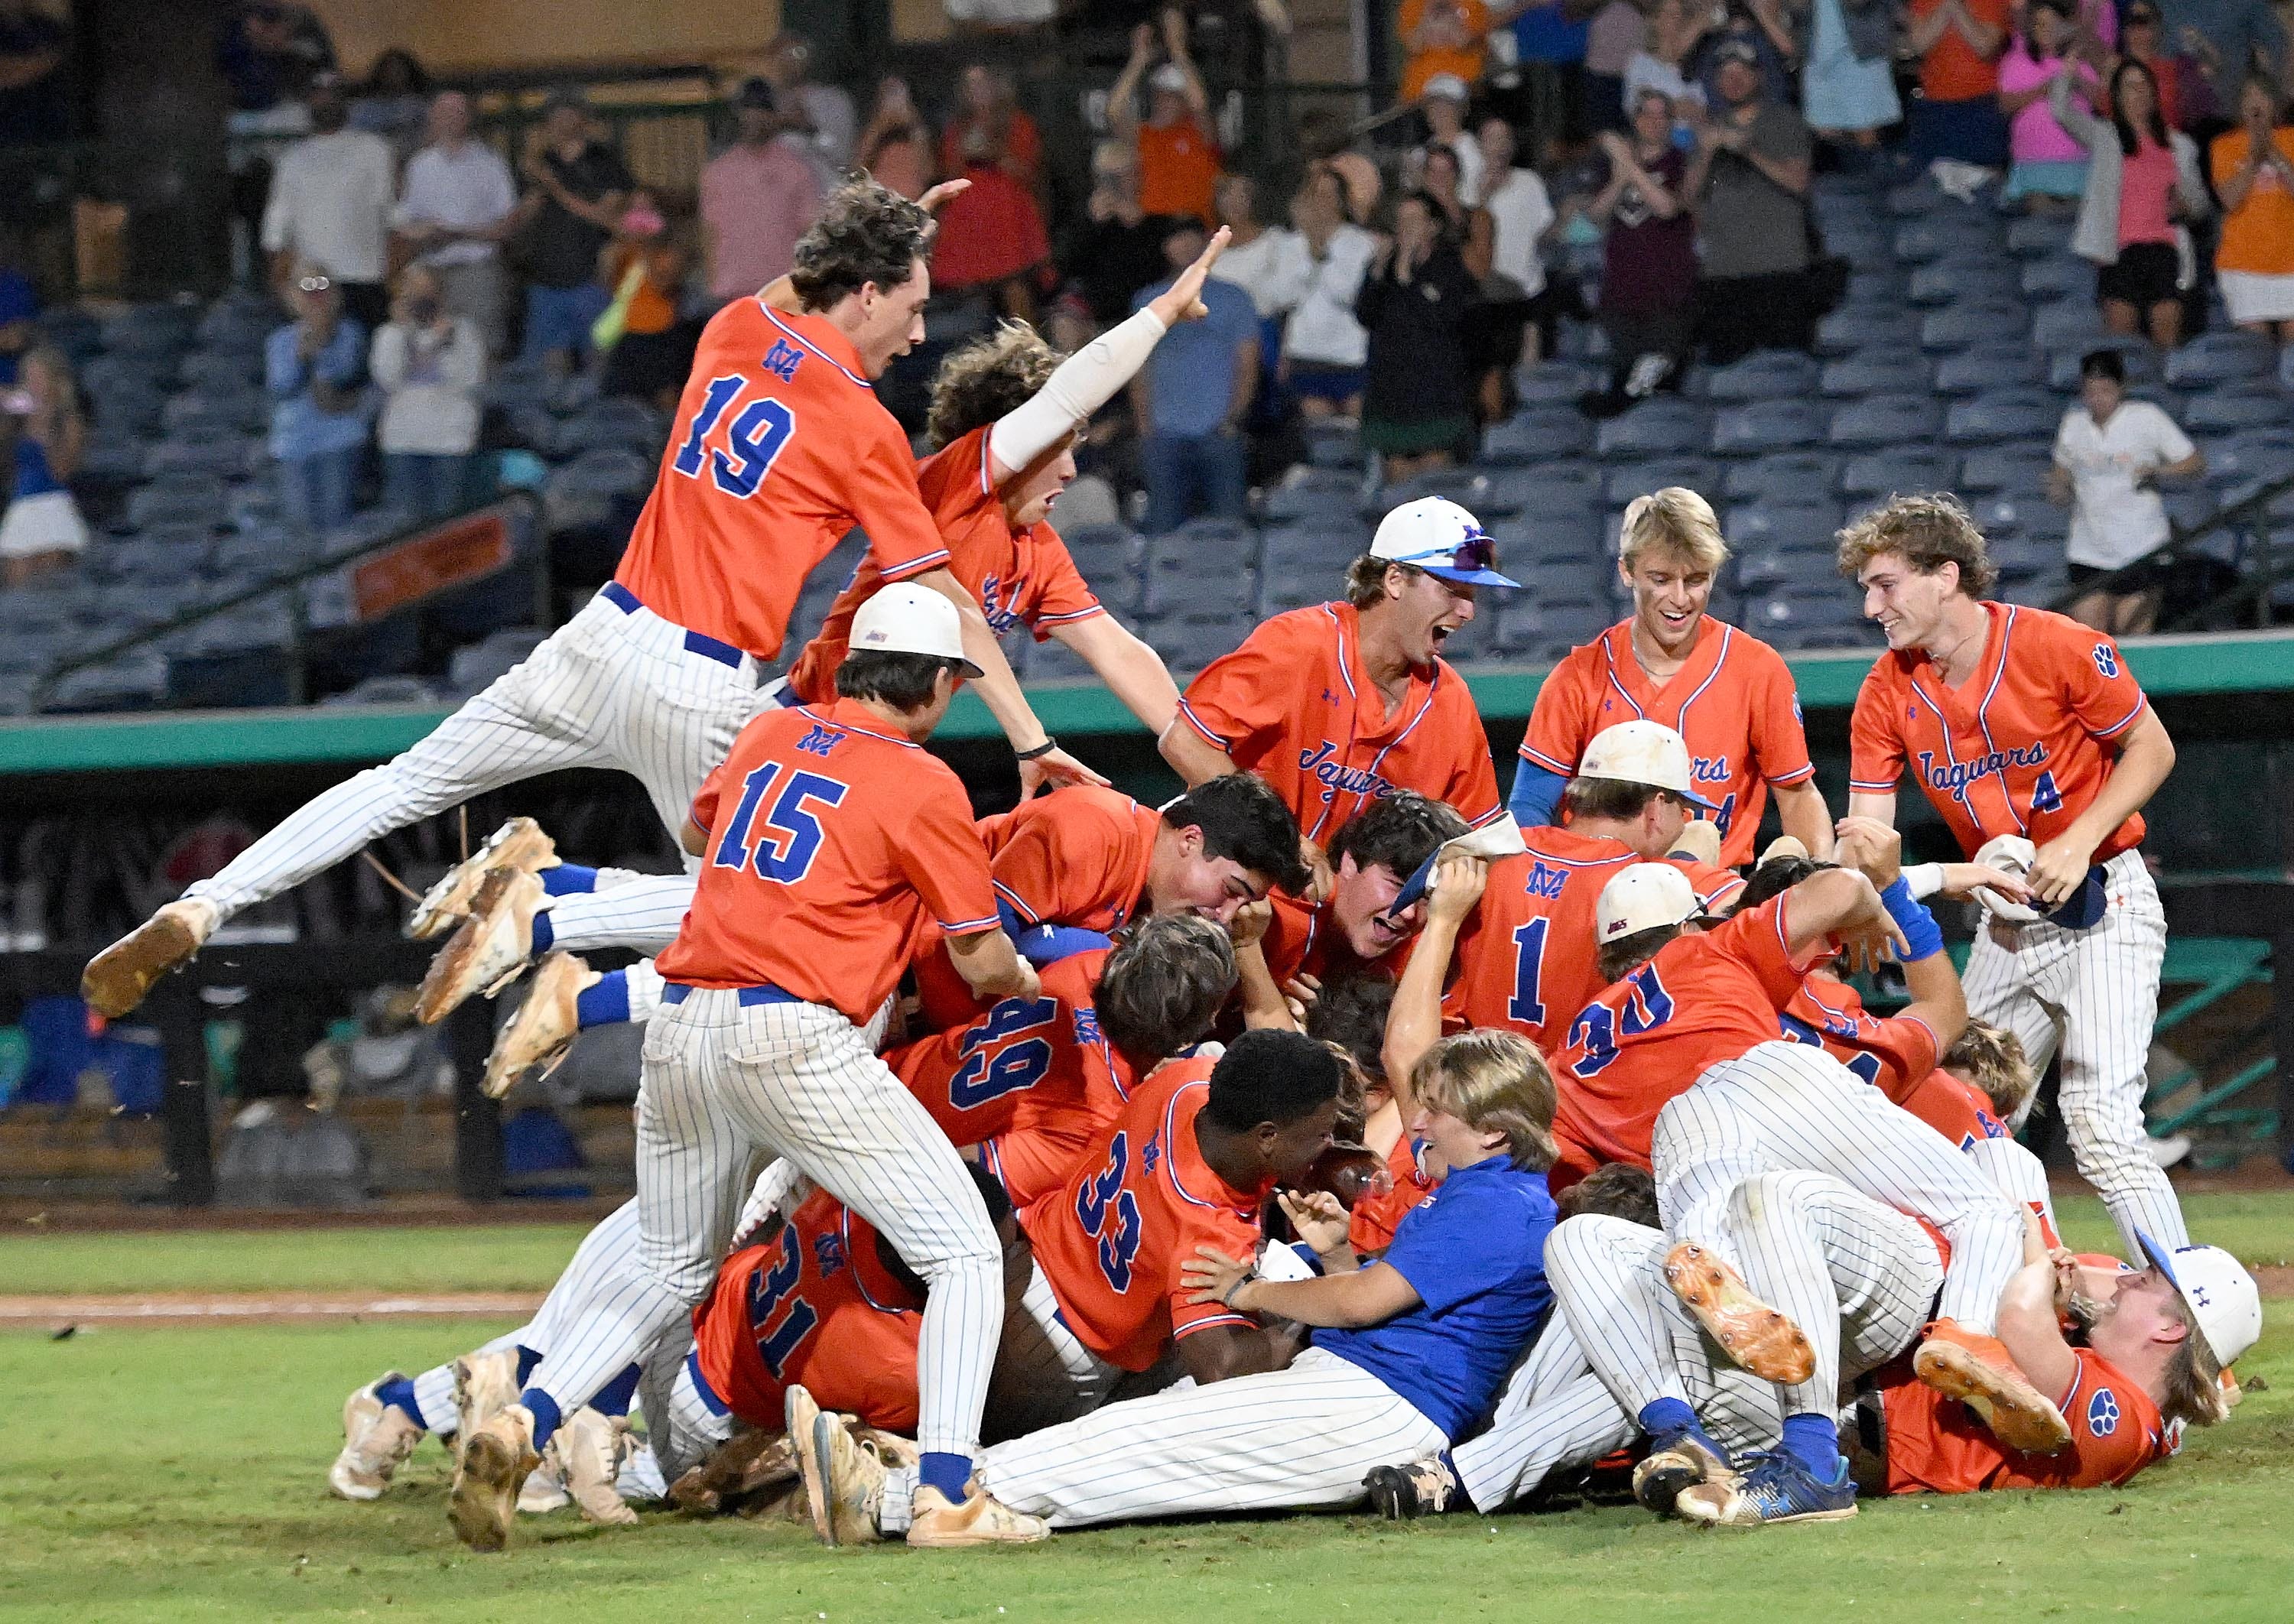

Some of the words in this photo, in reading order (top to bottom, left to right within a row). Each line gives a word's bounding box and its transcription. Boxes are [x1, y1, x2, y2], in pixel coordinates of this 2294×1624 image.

[672, 372, 795, 500] 19
[712, 759, 850, 886] 15
[1298, 739, 1396, 804] Jaguar
[1919, 741, 2050, 803] Jaguars
[2030, 770, 2063, 814] 4
[1507, 915, 1551, 1028] 1
[948, 996, 1058, 1112] 49
[1075, 1130, 1143, 1295] 33
[745, 1220, 819, 1382] 31
